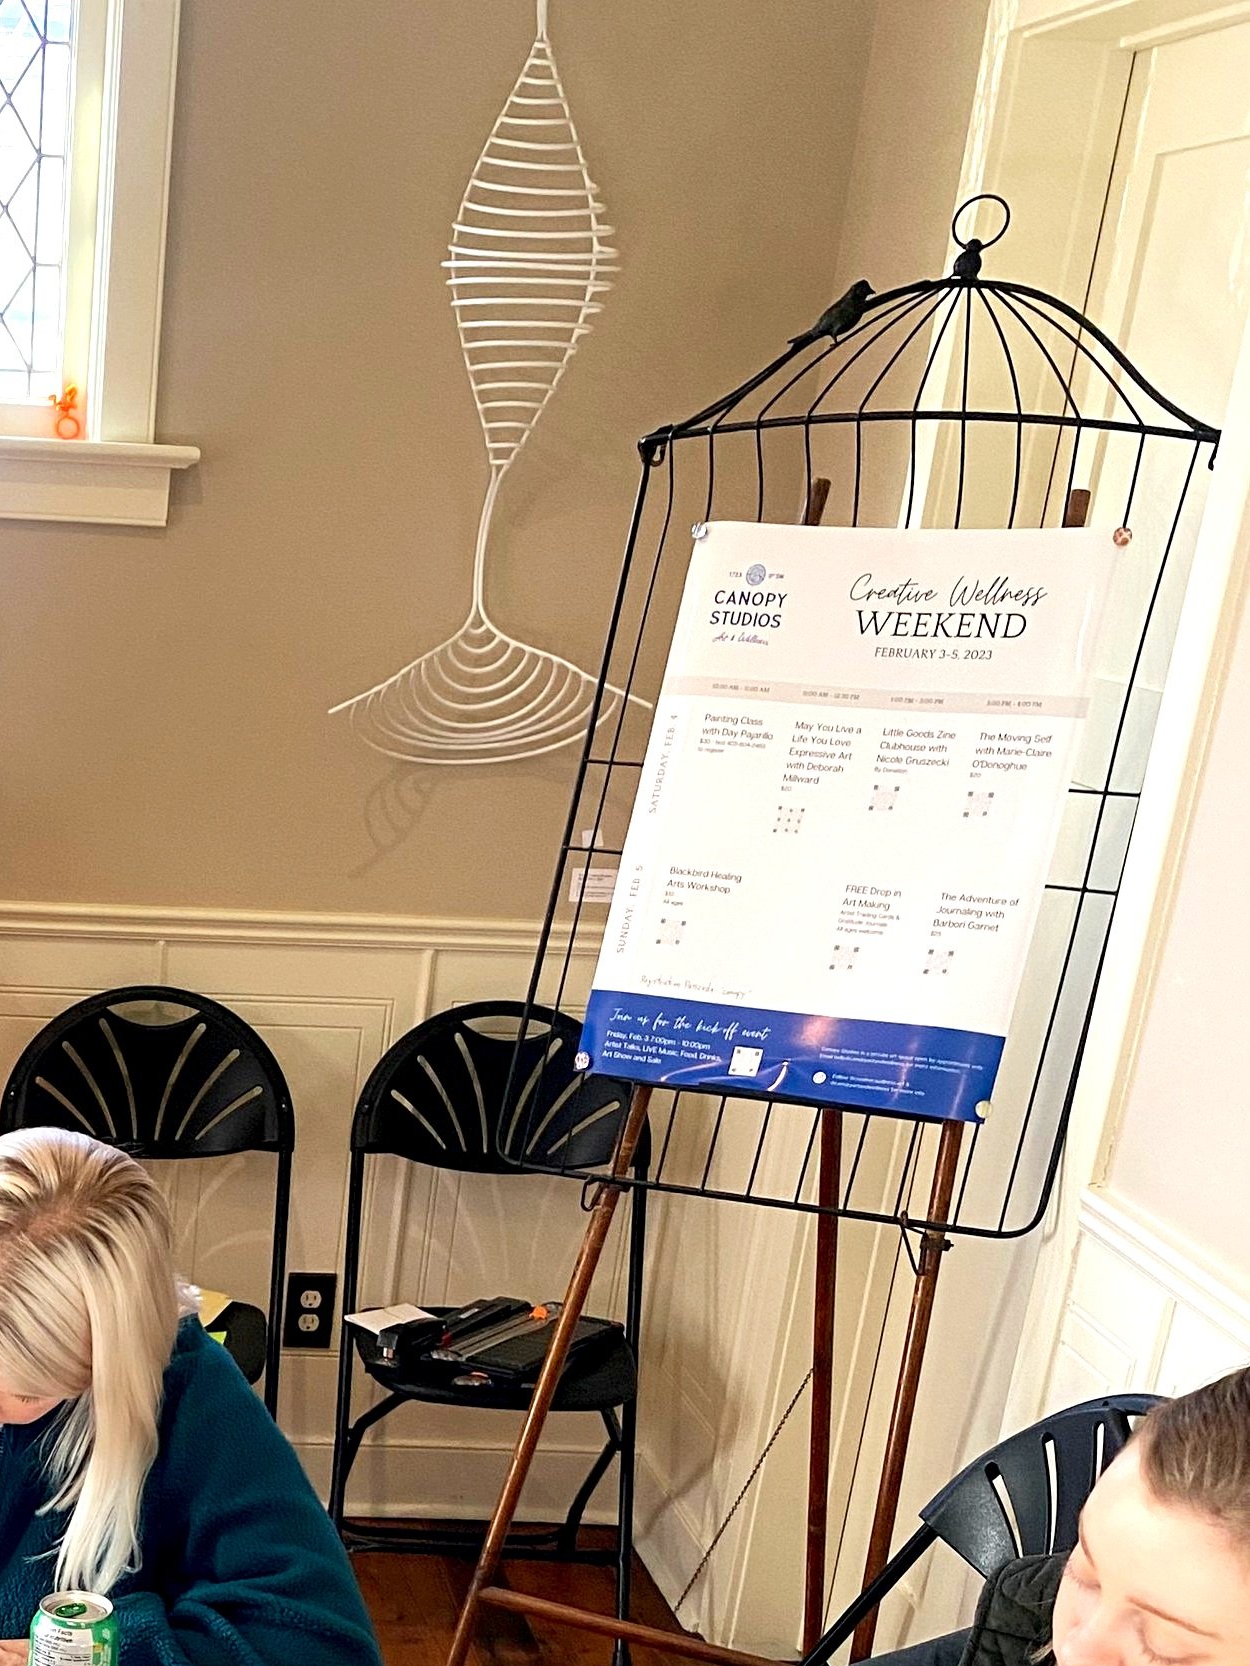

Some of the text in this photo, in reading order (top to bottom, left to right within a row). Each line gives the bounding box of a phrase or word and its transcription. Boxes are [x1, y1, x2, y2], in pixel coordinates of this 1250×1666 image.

[850, 573, 1048, 607] Creative Wellness
[714, 590, 787, 608] CANOPY
[710, 611, 781, 628] STUDIOS
[856, 610, 1027, 638] WEEKEND
[874, 647, 935, 659] FEBRUARY
[963, 650, 992, 660] 2023
[705, 714, 763, 726] Painting Class
[702, 728, 720, 736] with
[722, 729, 738, 739] Day
[795, 721, 814, 731] May
[817, 723, 833, 732] You
[836, 725, 854, 734] Live
[883, 728, 956, 739] Little Goods Zine
[664, 727, 675, 746] FEB
[792, 735, 851, 747] Life You Love
[980, 732, 1052, 744] The Moving Self
[880, 742, 926, 752] Clubhouse
[975, 747, 1052, 757] with Marie-Claire
[789, 748, 852, 760] Expressive Art
[876, 755, 949, 766] Nicole Gruszecki
[787, 762, 843, 773] with Deborah
[972, 760, 1027, 771] O'Donoghue
[783, 774, 819, 784] Millward
[670, 867, 742, 883] Blackbird Healing
[630, 878, 643, 896] FEB
[667, 880, 730, 894] Arts Workshop
[846, 885, 868, 894] FREE
[870, 887, 891, 897] Drop
[843, 898, 890, 911] Art Making
[942, 893, 1019, 906] The Adventure of
[936, 906, 1004, 919] Journaling with
[933, 919, 999, 932] Barbori Garnet
[610, 1007, 632, 1021] Join
[637, 1015, 649, 1025] us
[653, 1012, 669, 1030] for
[673, 1016, 692, 1029] the
[742, 1028, 771, 1040] event
[604, 1041, 622, 1049] Artist
[643, 1045, 657, 1053] LIVE
[682, 1040, 711, 1050] 10:00pm
[602, 1050, 661, 1064] Art Show and Sale
